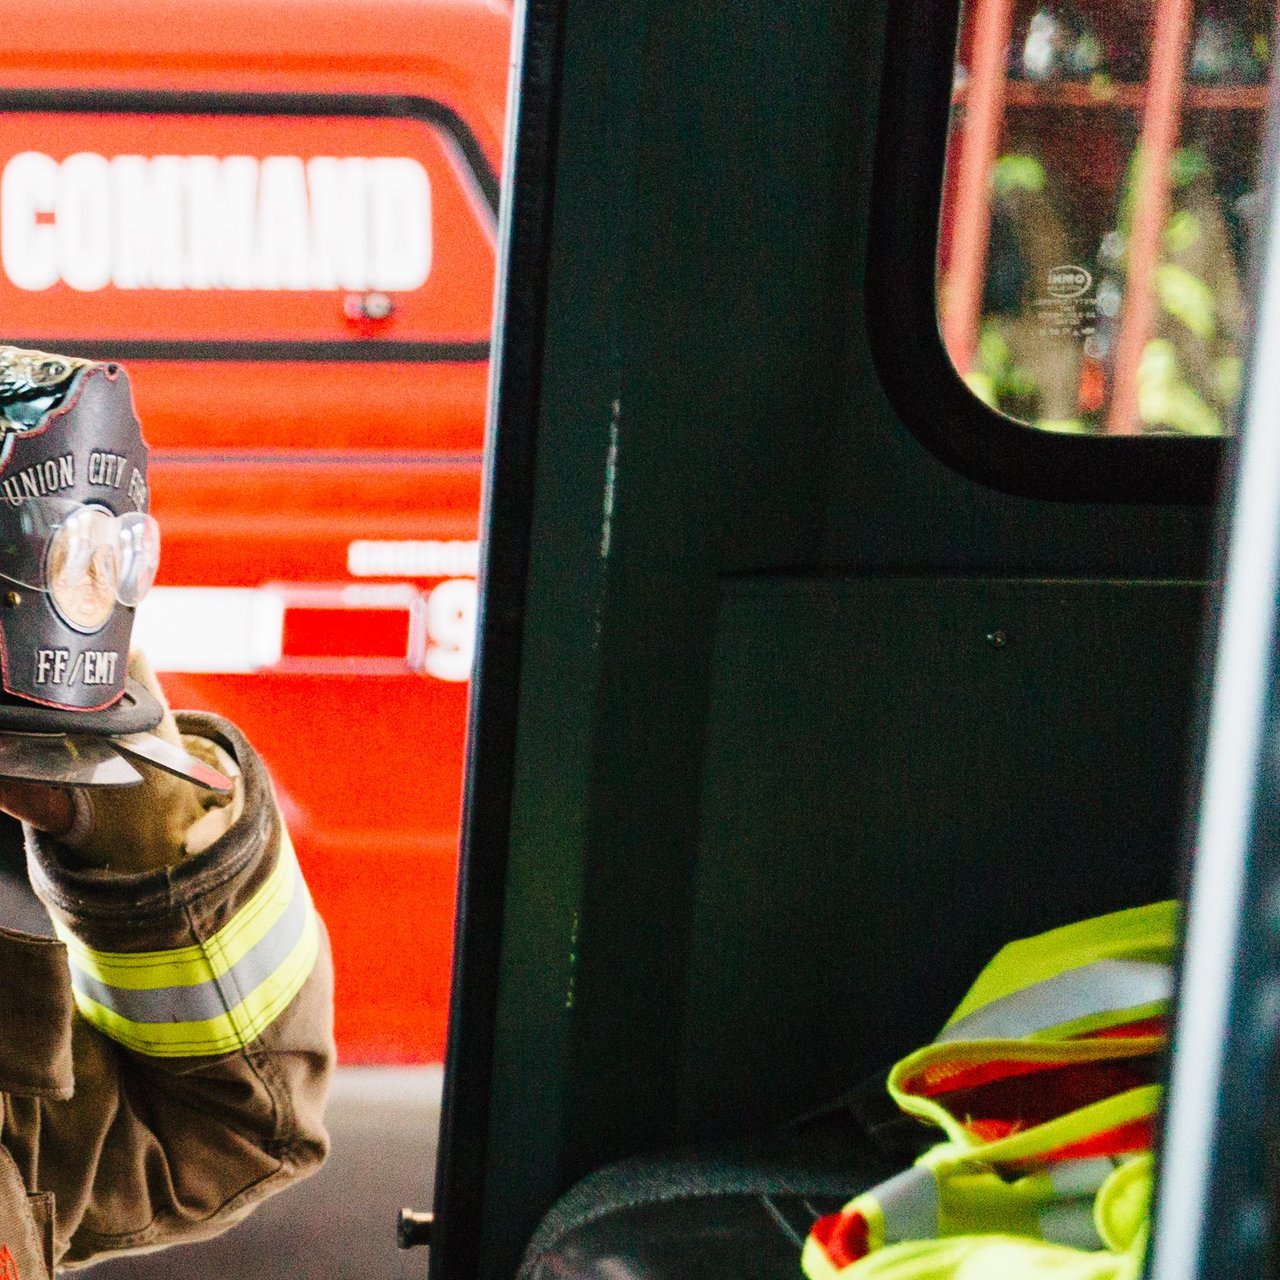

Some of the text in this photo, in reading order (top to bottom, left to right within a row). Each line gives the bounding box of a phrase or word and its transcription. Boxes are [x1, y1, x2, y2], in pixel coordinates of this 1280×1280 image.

[1, 151, 432, 292] COMMAND
[3, 452, 127, 506] UNION CITY
[37, 649, 118, 687] FF/EMT
